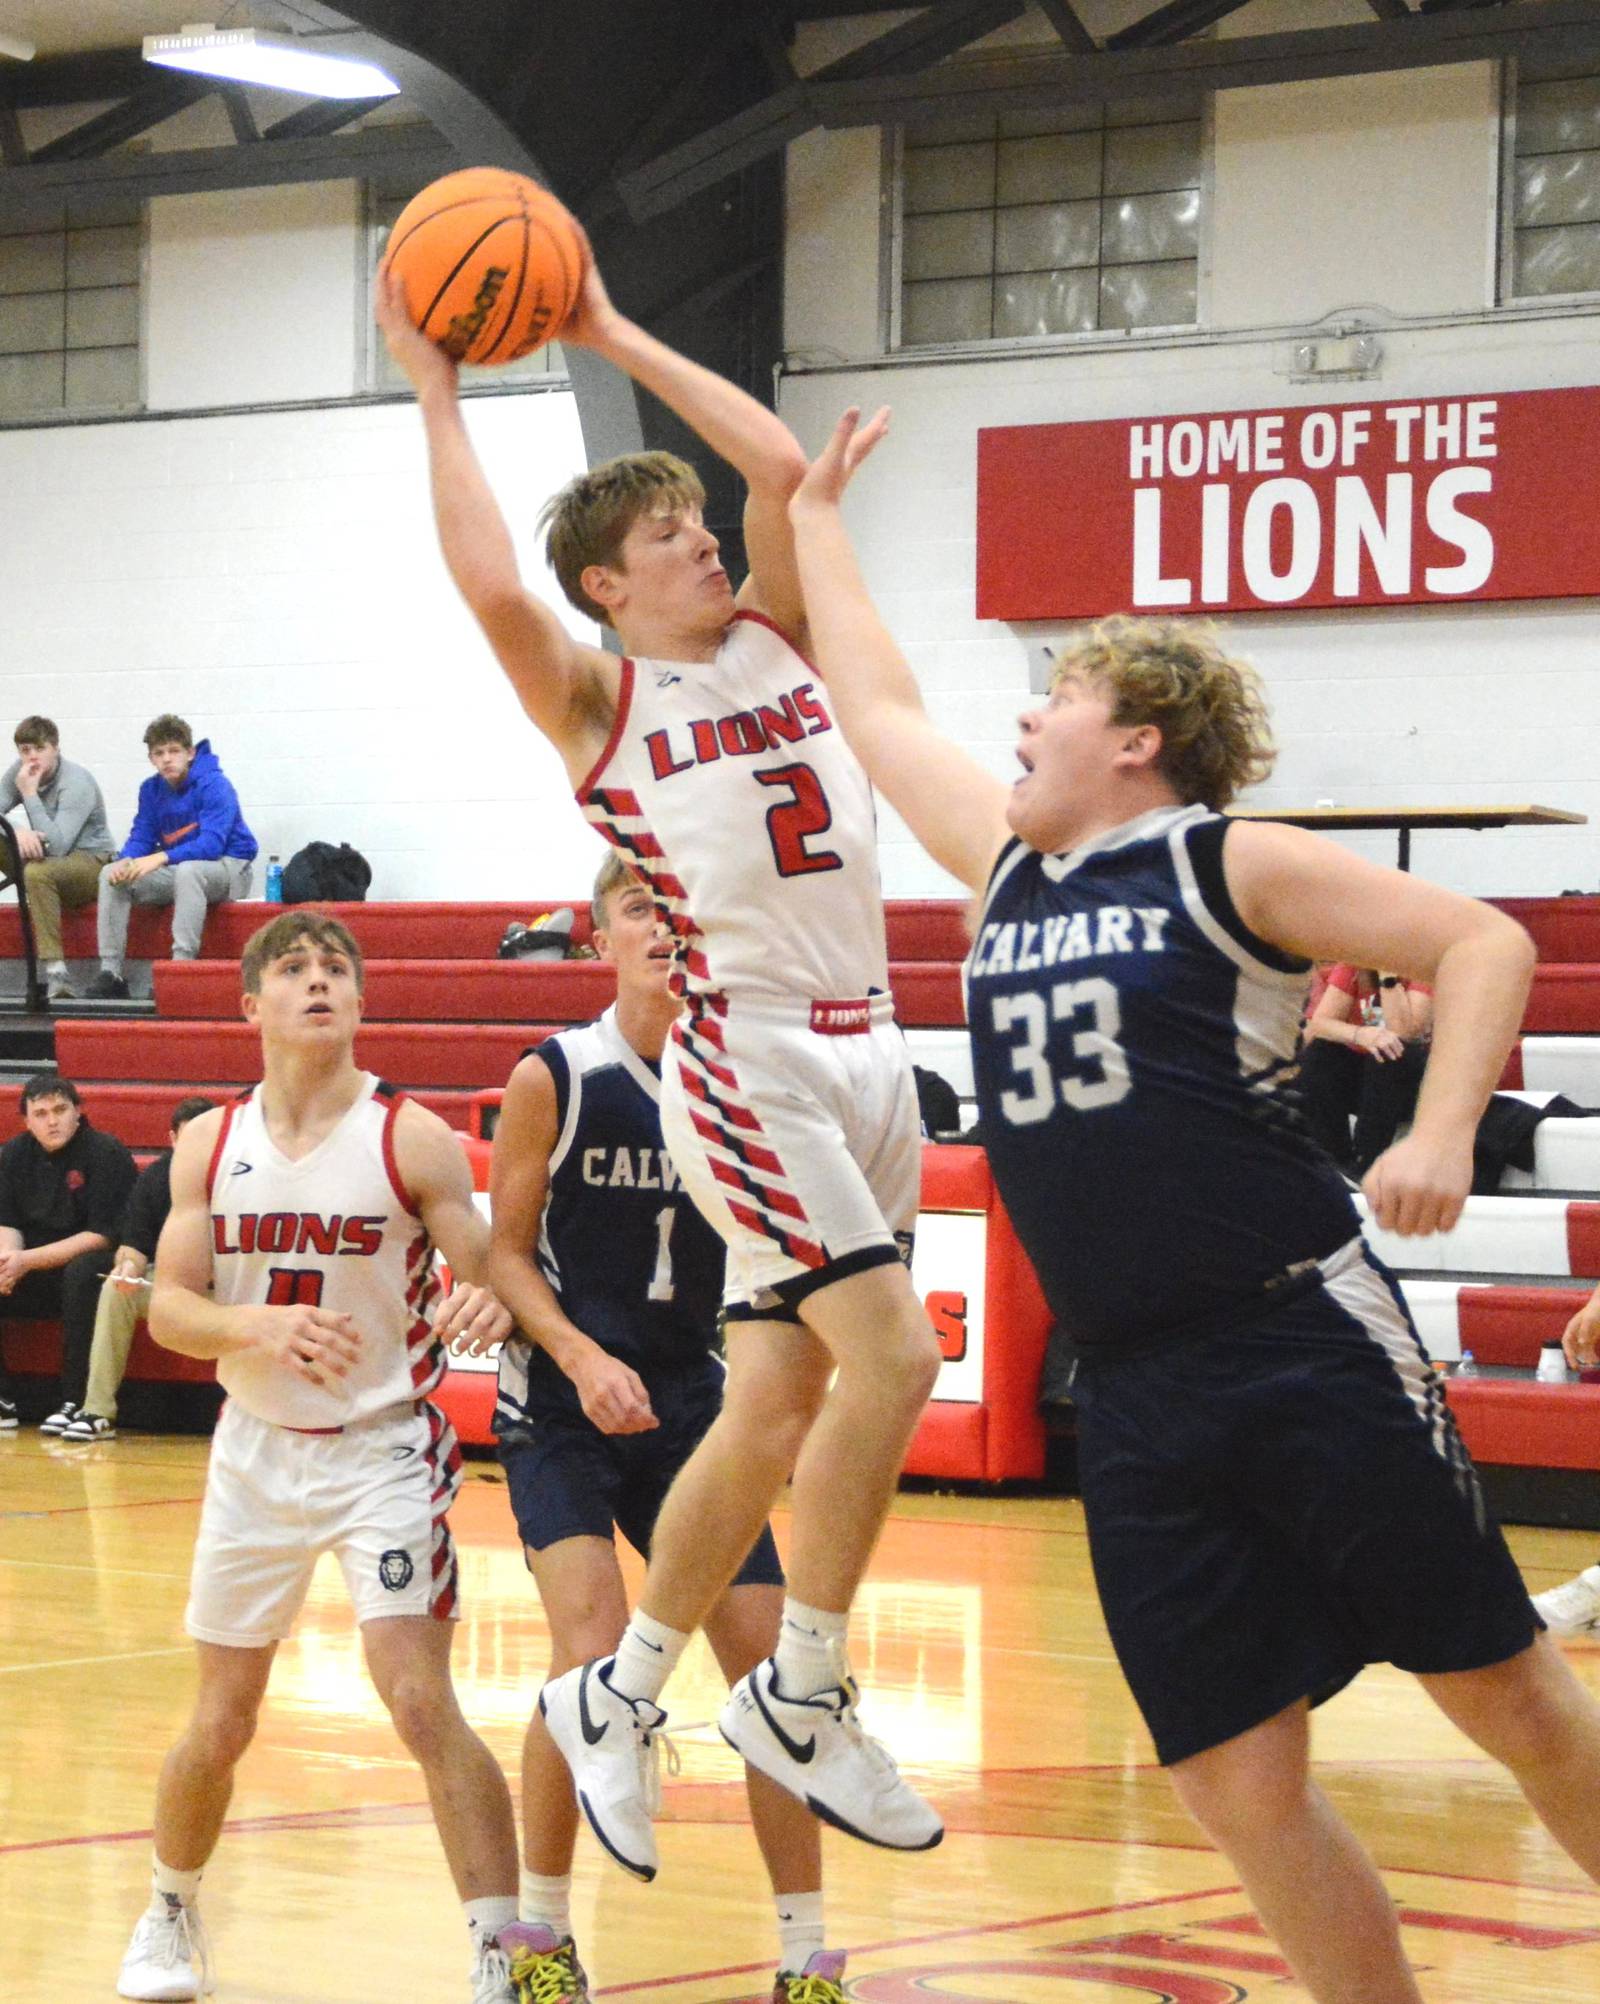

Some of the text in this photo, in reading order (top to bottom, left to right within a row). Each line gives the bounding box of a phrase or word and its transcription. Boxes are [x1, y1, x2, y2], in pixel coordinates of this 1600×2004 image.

[1129, 401, 1498, 479] HOME OF THE
[1132, 466, 1495, 606] LIONS
[644, 682, 832, 781] LIONS
[753, 761, 843, 878] 2
[972, 905, 1170, 978] CALVARY
[992, 977, 1133, 1126] 33
[582, 1146, 688, 1192] CALV
[212, 1212, 388, 1256] LIONS
[647, 1207, 676, 1301] 1
